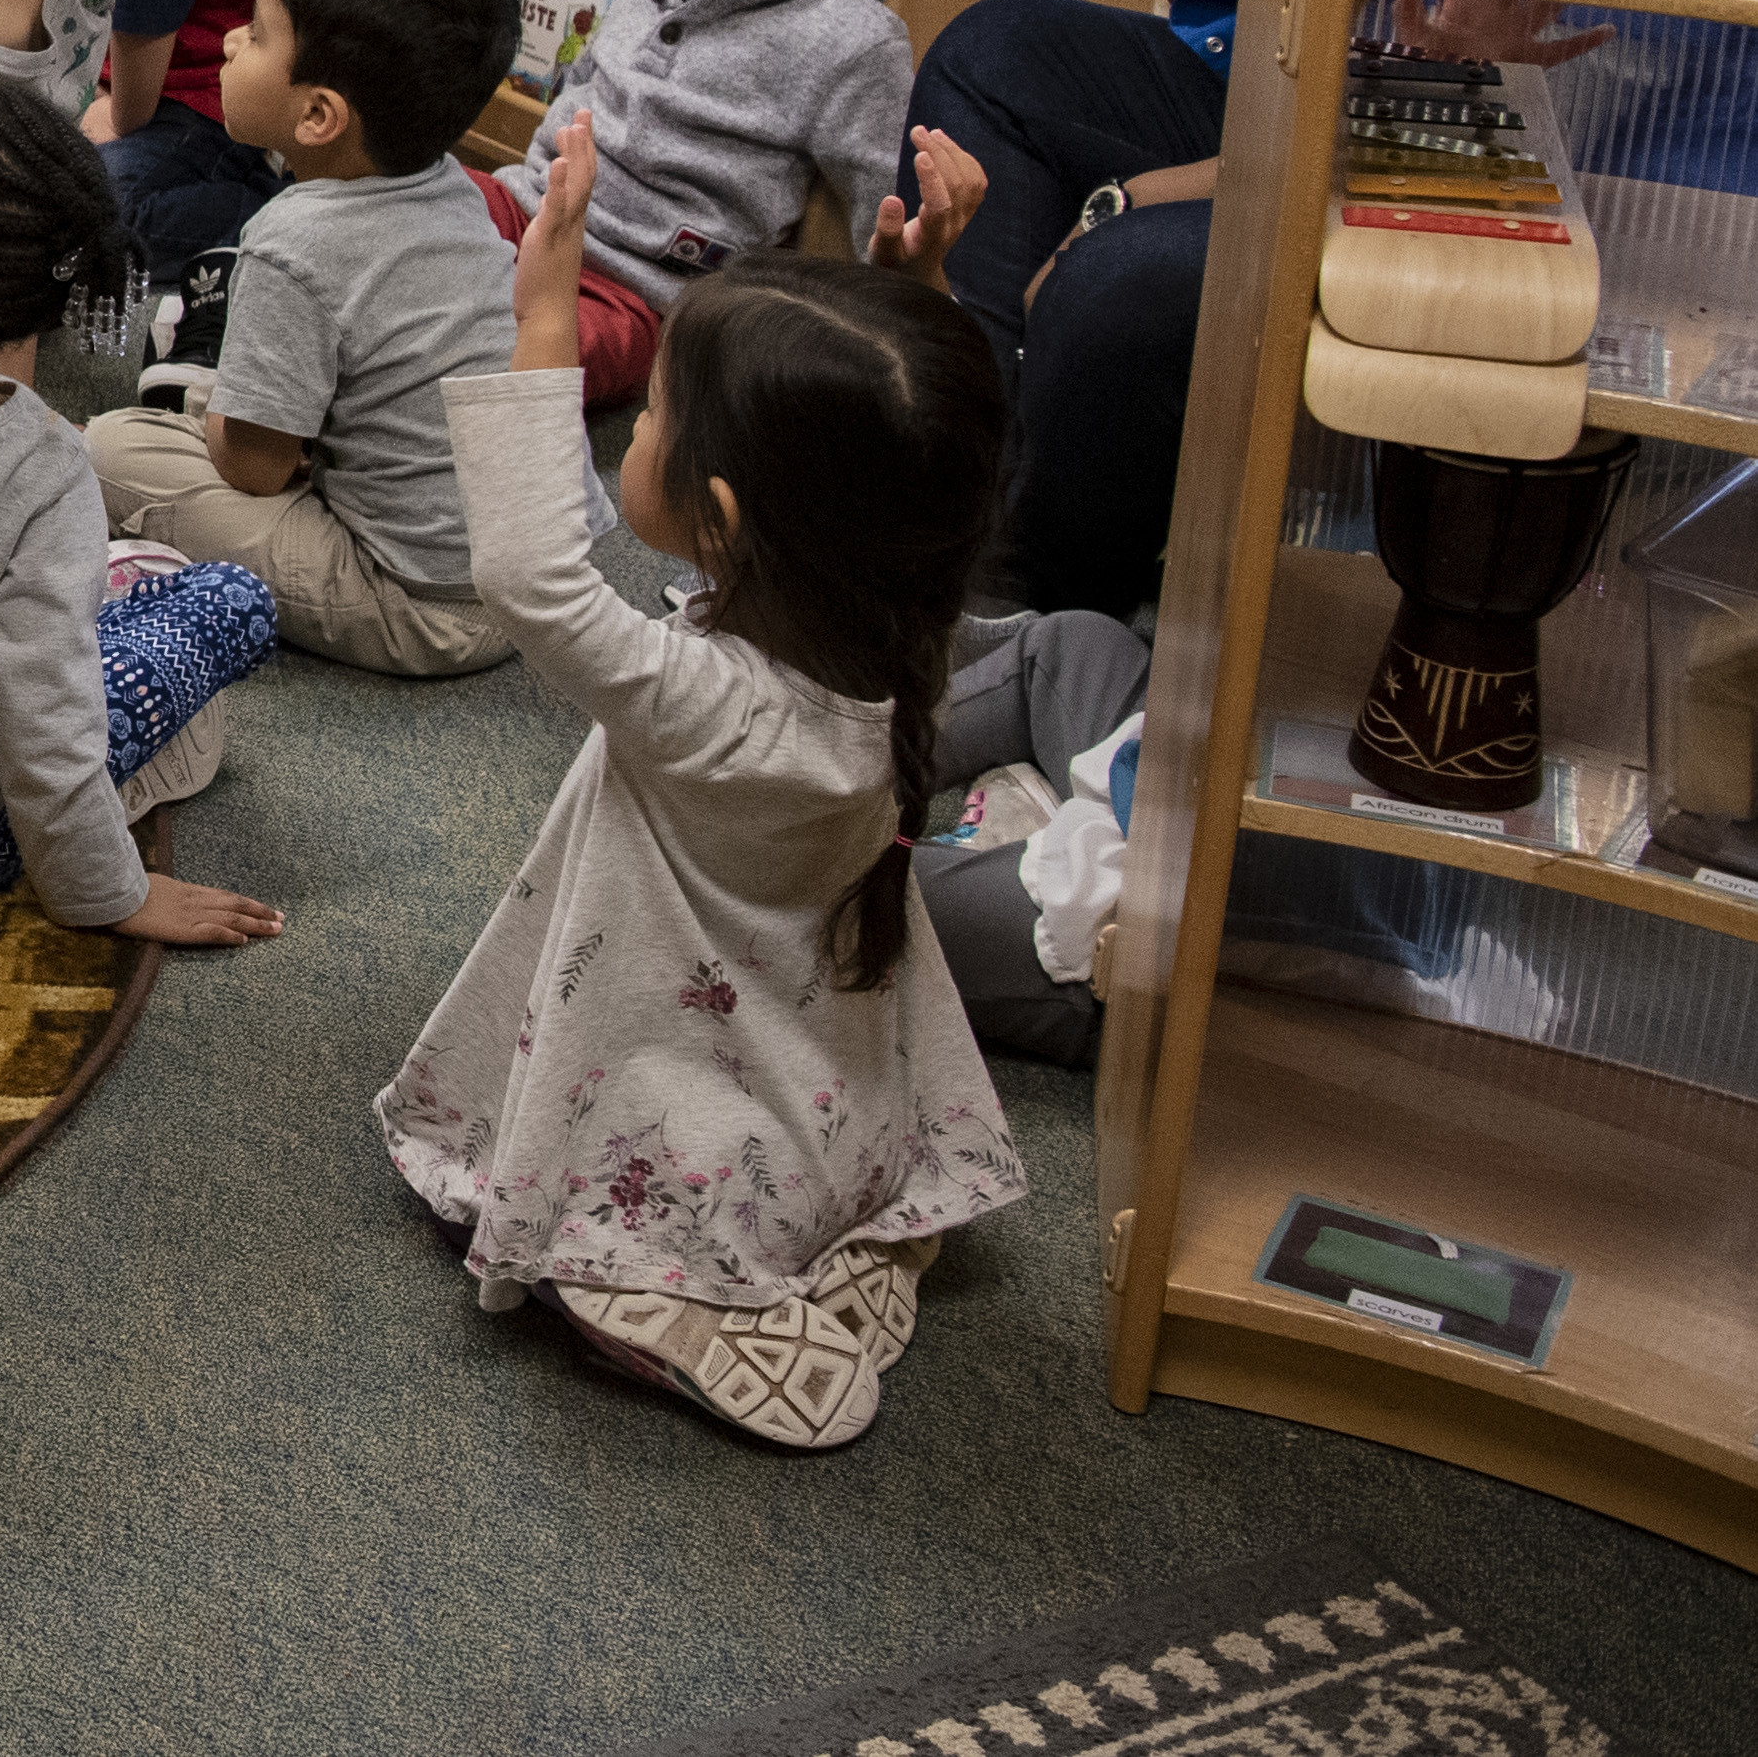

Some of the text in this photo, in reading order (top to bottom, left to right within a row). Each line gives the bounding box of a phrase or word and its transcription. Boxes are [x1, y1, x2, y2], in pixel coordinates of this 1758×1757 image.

[1360, 800, 1499, 830] African drum
[1356, 1298, 1432, 1326] scarves
